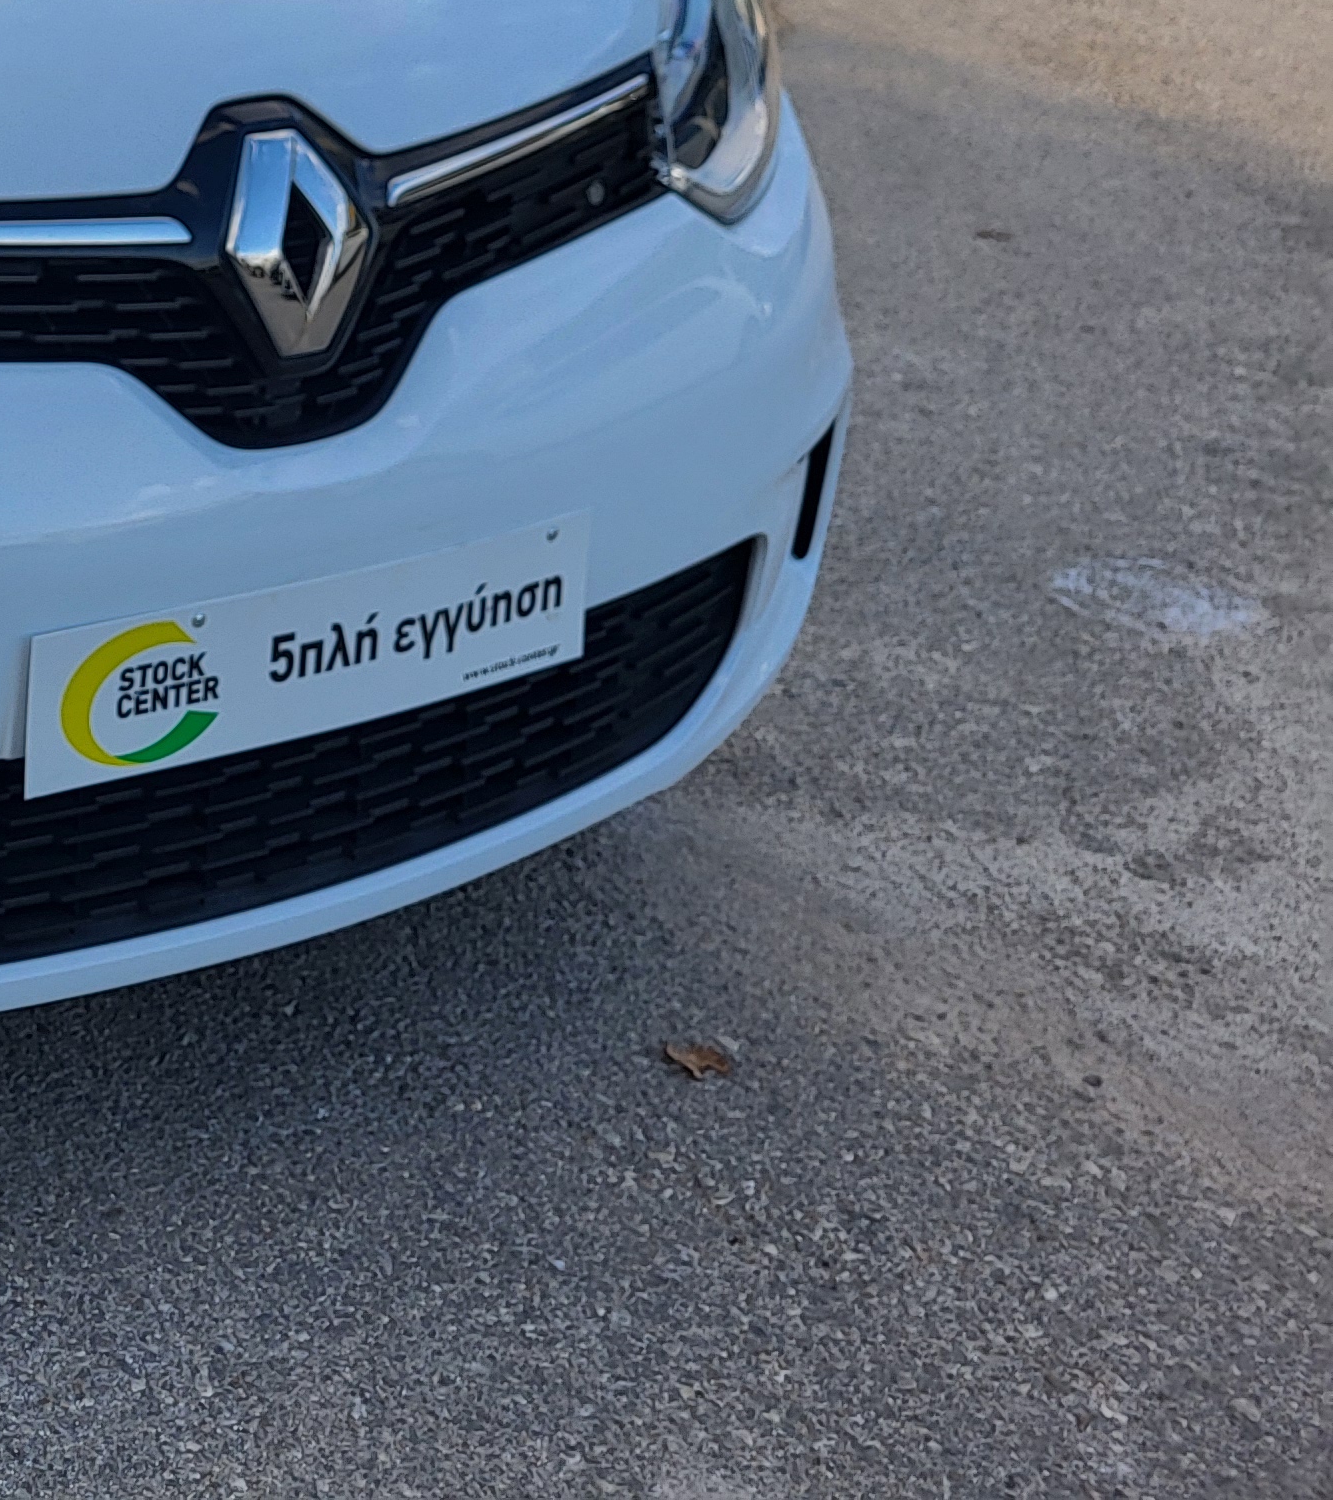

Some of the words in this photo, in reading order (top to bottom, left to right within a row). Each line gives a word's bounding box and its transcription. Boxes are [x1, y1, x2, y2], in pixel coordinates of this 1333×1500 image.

[269, 612, 378, 682] 5πλή
[393, 574, 563, 660] εγγύηση
[119, 652, 206, 691] STOCK
[116, 676, 220, 719] CENTER
